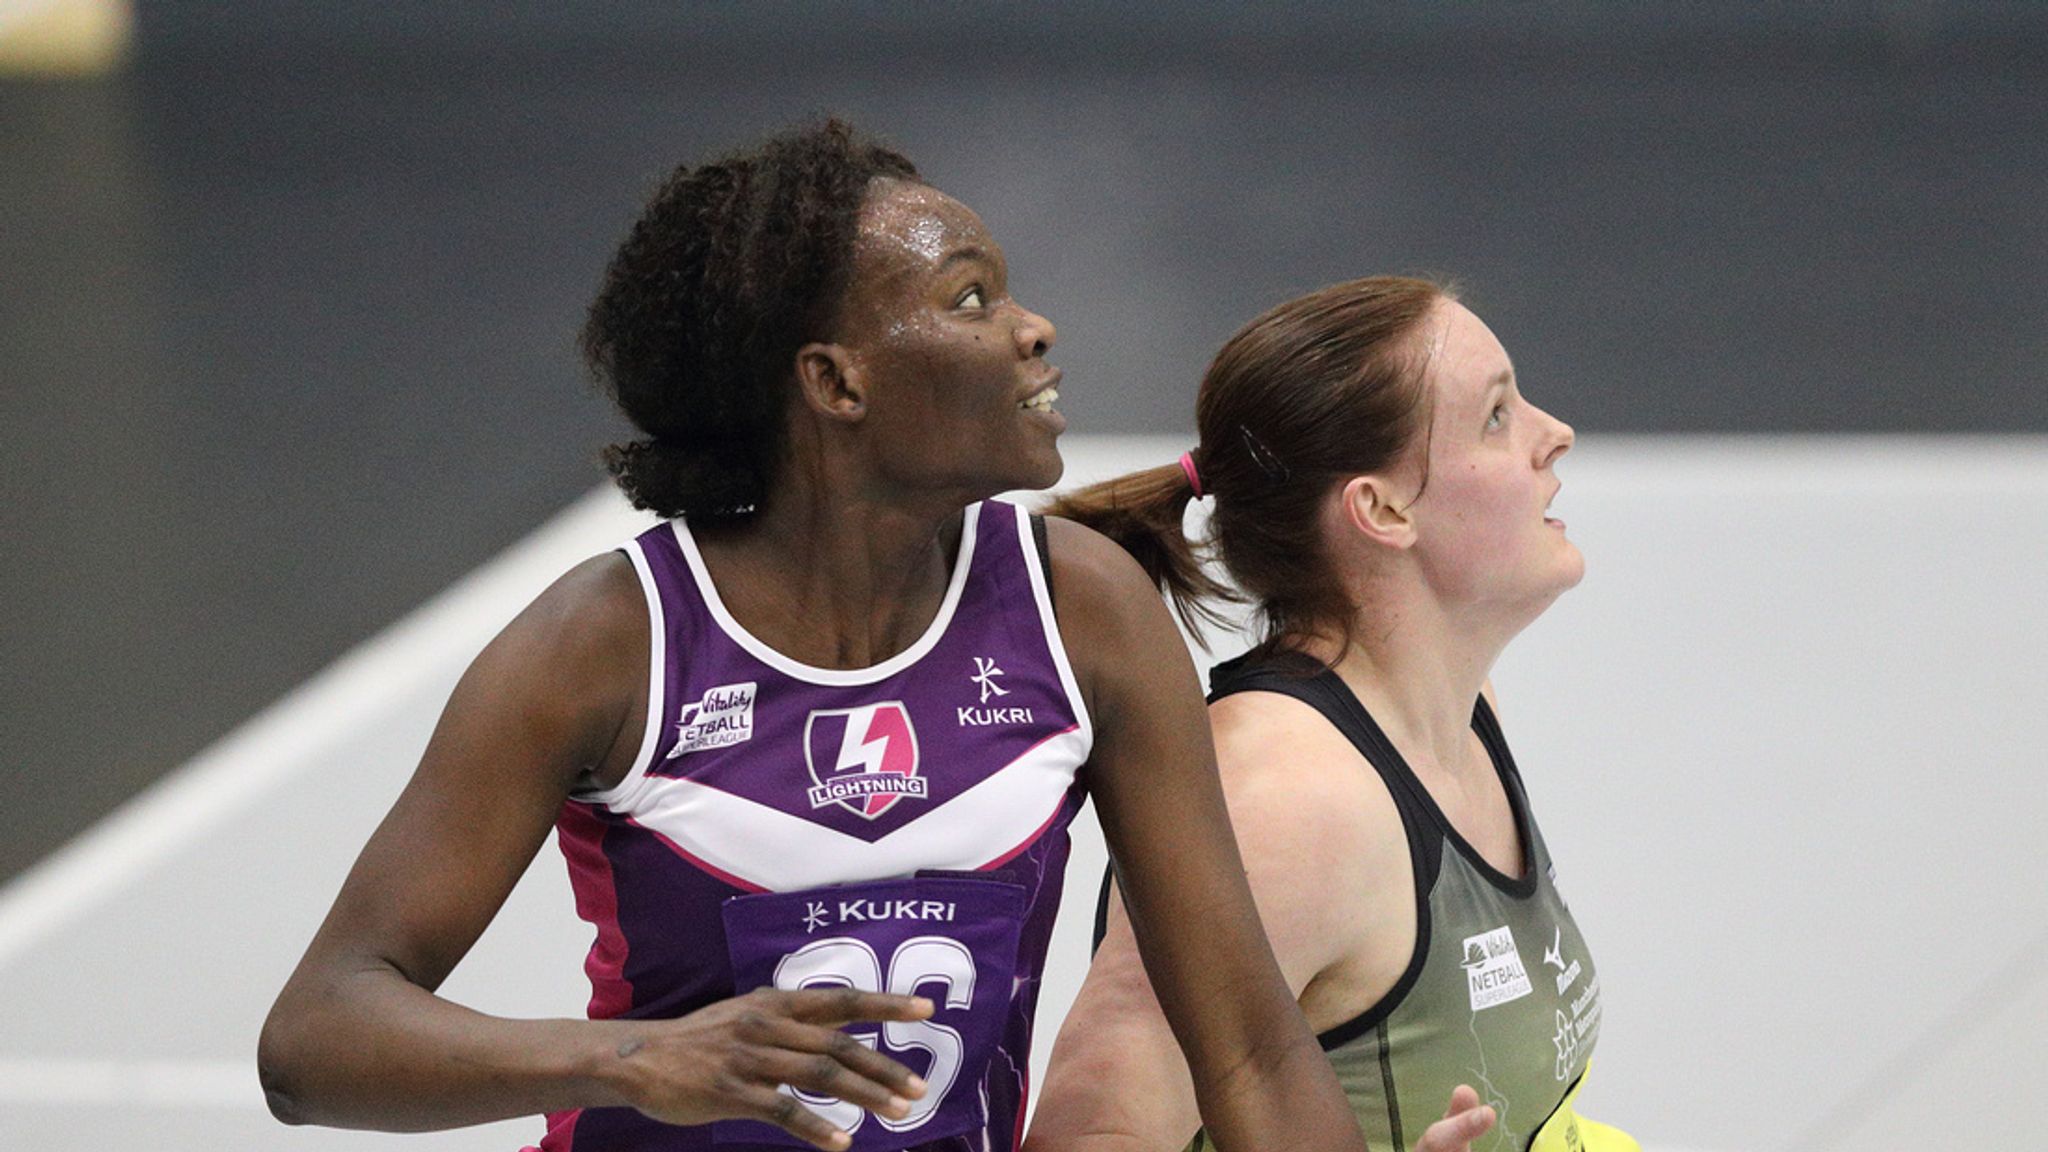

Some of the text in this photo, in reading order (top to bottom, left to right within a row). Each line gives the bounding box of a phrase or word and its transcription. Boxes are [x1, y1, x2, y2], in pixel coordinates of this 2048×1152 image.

[702, 689, 752, 713] Vitality
[684, 715, 749, 740] ETBALL
[956, 706, 1034, 727] KUKRI
[814, 777, 922, 803] LIGHTNING
[839, 899, 956, 922] KUKRI
[1472, 963, 1525, 993] NETBALL
